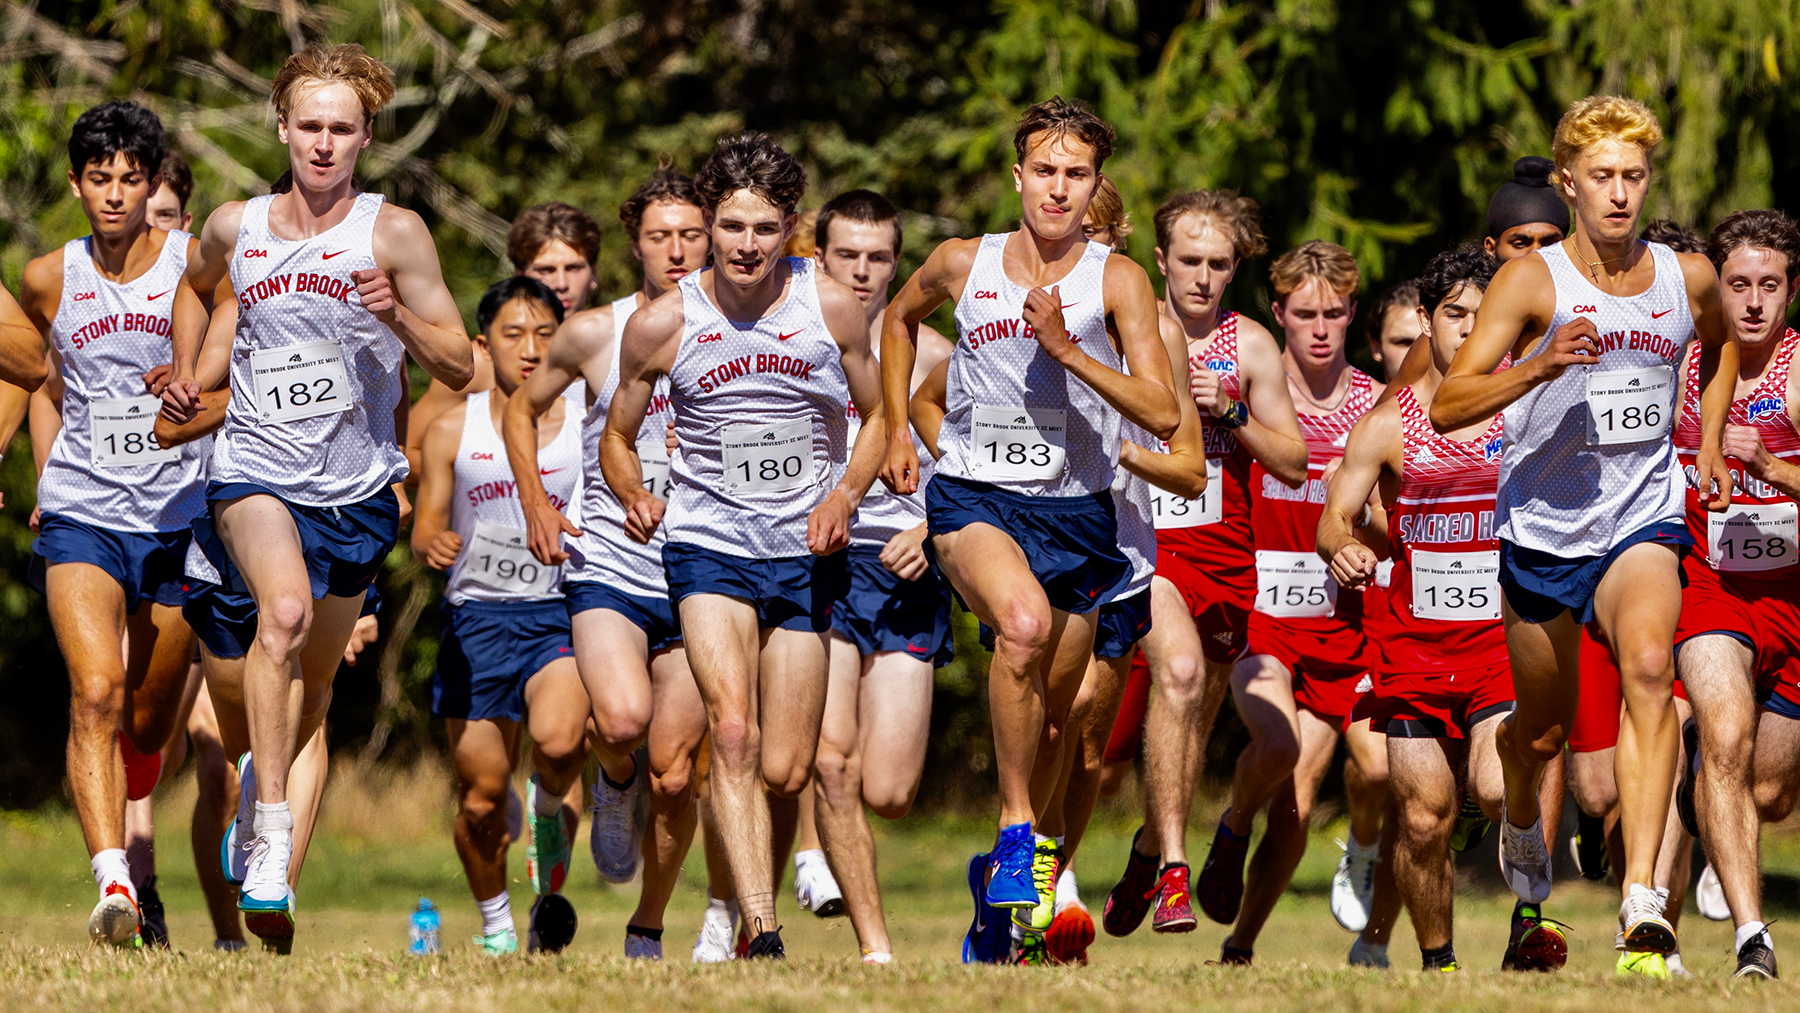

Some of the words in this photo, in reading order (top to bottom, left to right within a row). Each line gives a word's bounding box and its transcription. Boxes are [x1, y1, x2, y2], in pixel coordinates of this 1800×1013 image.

[243, 249, 267, 258] CAA
[74, 292, 96, 301] CAA
[240, 273, 292, 310] STONY
[296, 273, 355, 304] BROOK
[975, 291, 997, 300] CAA
[1573, 305, 1597, 313] CAA
[71, 314, 119, 350] STONY
[697, 333, 722, 343] CAA
[968, 319, 1020, 350] STONY
[1629, 331, 1679, 361] BROOK
[287, 361, 316, 370] UNIVERSITY
[698, 355, 751, 393] STONY
[757, 354, 815, 381] BROOK
[267, 378, 337, 409] 182
[1625, 386, 1651, 394] UNIVERSITY
[1601, 404, 1660, 431] 186
[1748, 398, 1782, 420] MAAC
[984, 441, 1051, 467] 183
[737, 456, 802, 482] 180
[468, 480, 516, 507] STONY
[1151, 494, 1206, 516] 131
[1400, 512, 1474, 543] SACRED
[1722, 537, 1786, 559] 158
[480, 554, 538, 584] 190
[1266, 585, 1326, 606] 155
[1424, 586, 1488, 608] 135
